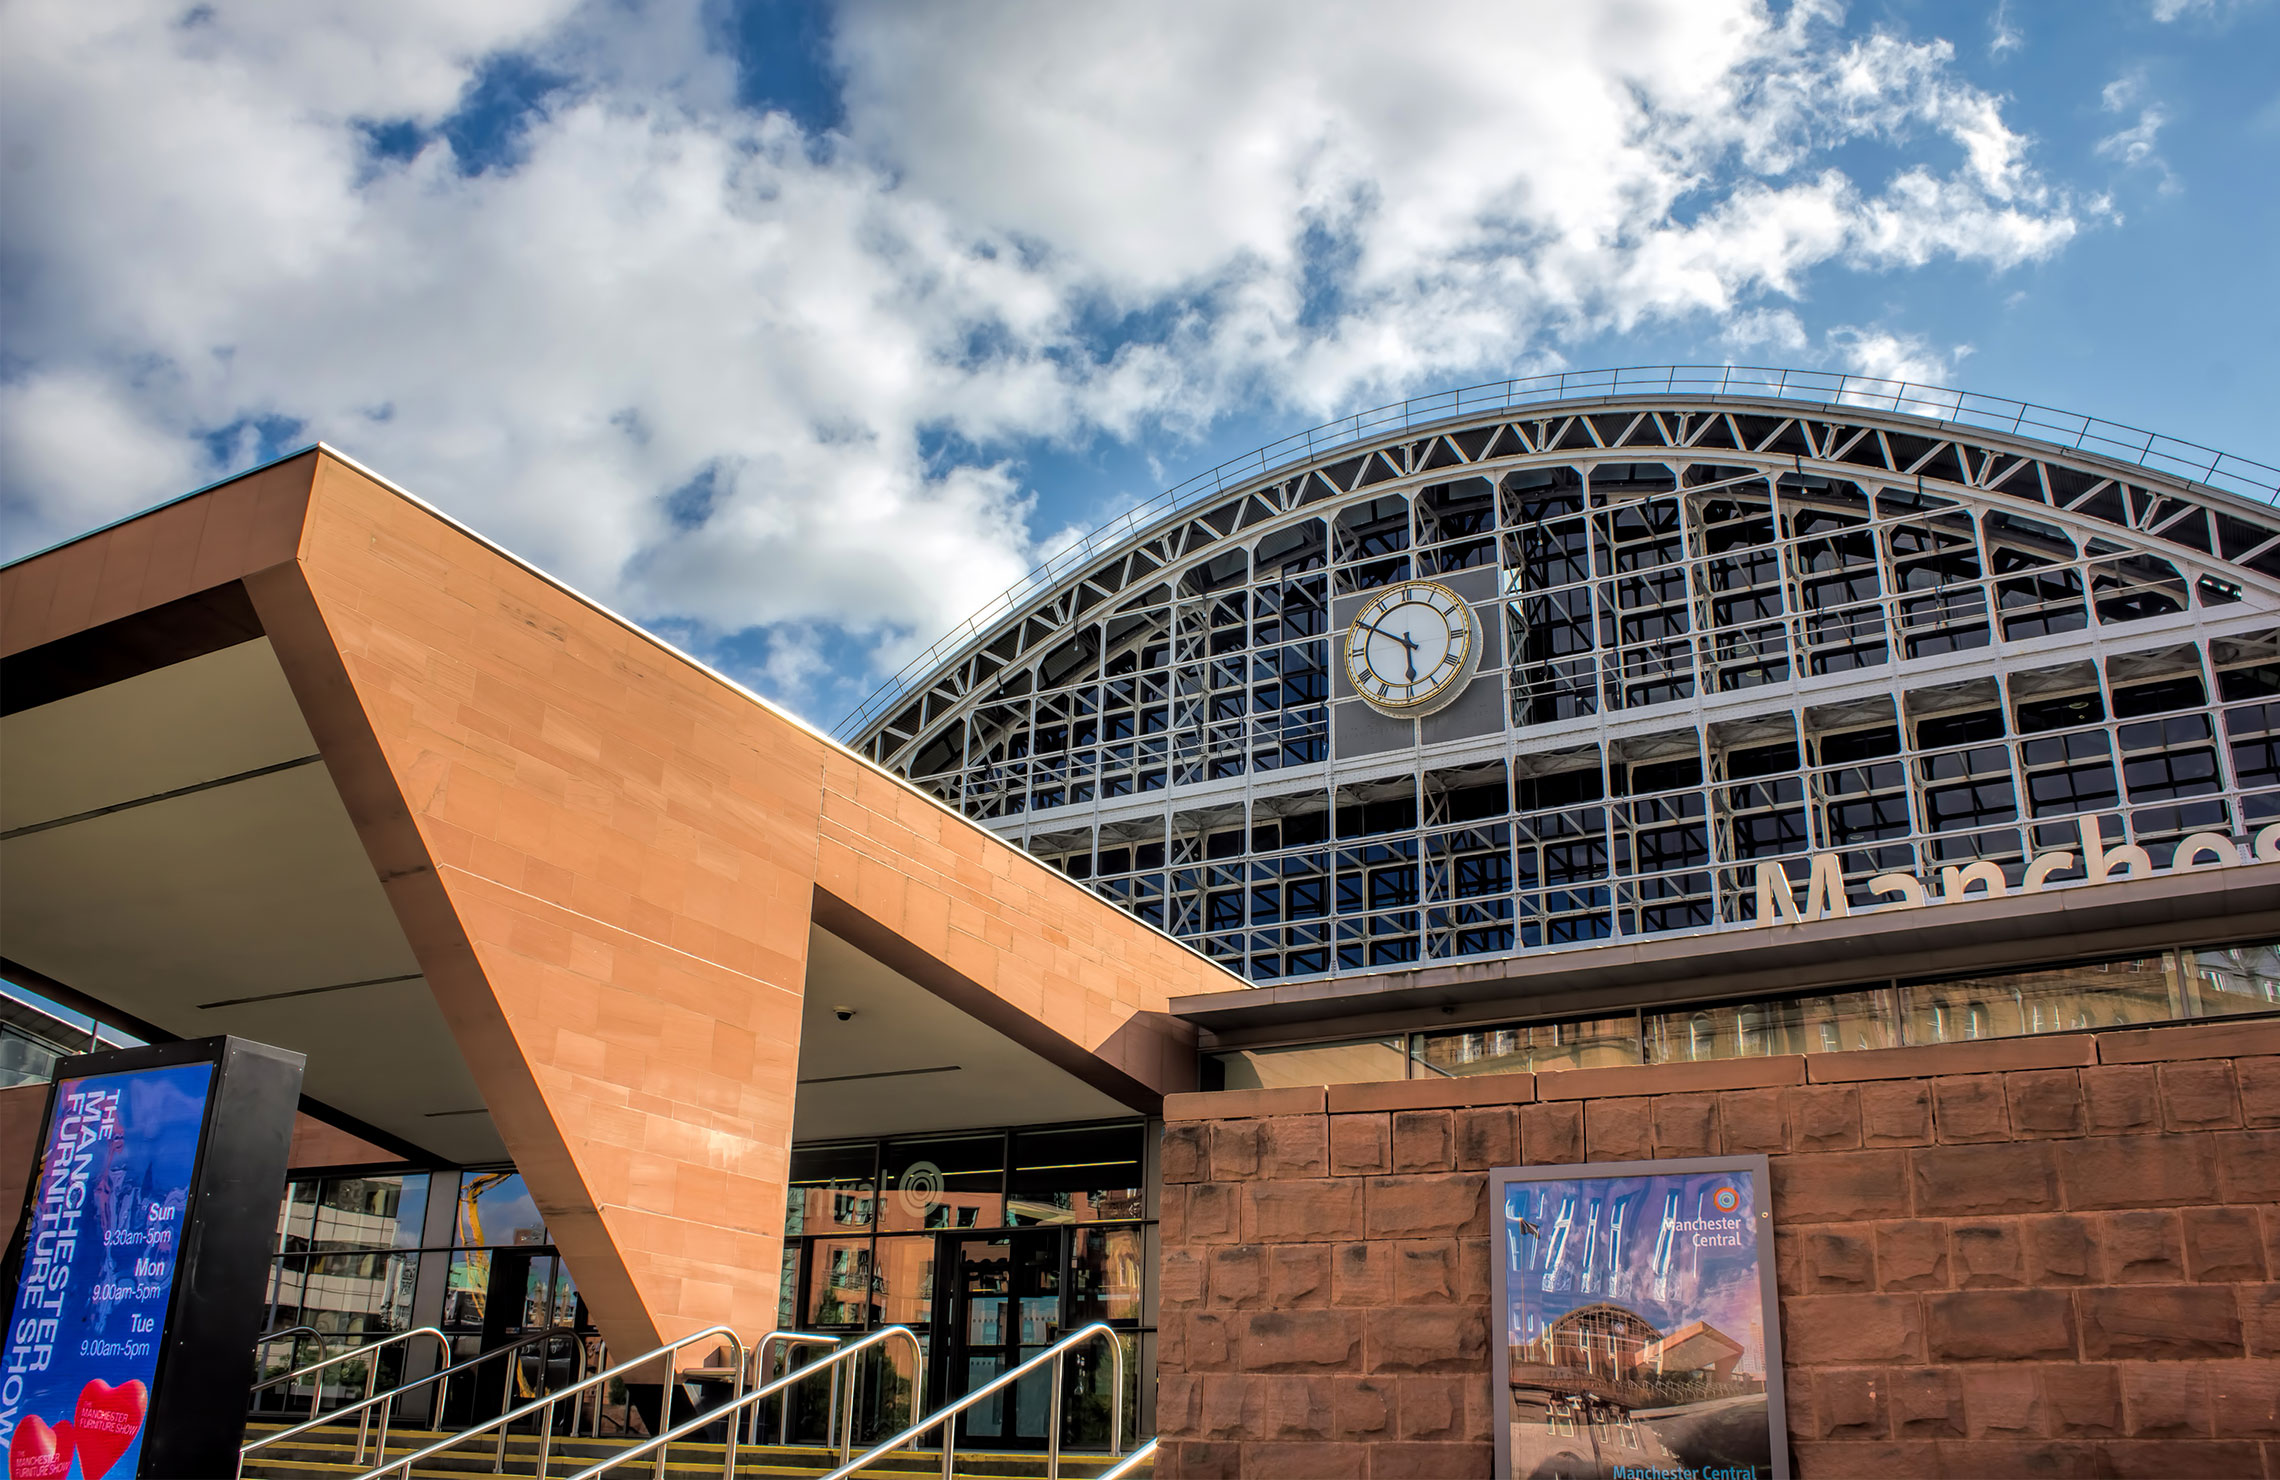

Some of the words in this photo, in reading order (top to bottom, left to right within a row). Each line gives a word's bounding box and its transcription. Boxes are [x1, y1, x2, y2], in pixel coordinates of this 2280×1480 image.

[98, 1088, 121, 1141] THE
[22, 1092, 86, 1310] FURNITURE
[804, 1169, 888, 1217] ntral
[149, 1202, 176, 1221] Sun
[28, 1090, 106, 1372] MANCHESTER
[1663, 1217, 1741, 1232] Manchester
[103, 1228, 172, 1247] 9.30am-5pm
[1692, 1231, 1742, 1247] Central
[134, 1258, 165, 1277] Mon
[92, 1283, 161, 1303] 9.00am-5pm
[131, 1313, 154, 1333] Tue
[80, 1339, 150, 1359] 9.00am-5pm
[0, 1317, 37, 1449] SHOW
[81, 1407, 128, 1423] MANCHESTER
[80, 1418, 116, 1432] FURNITURE
[115, 1423, 138, 1436] SHOW
[1613, 1465, 1699, 1480] Manchester
[1702, 1465, 1757, 1480] Central
